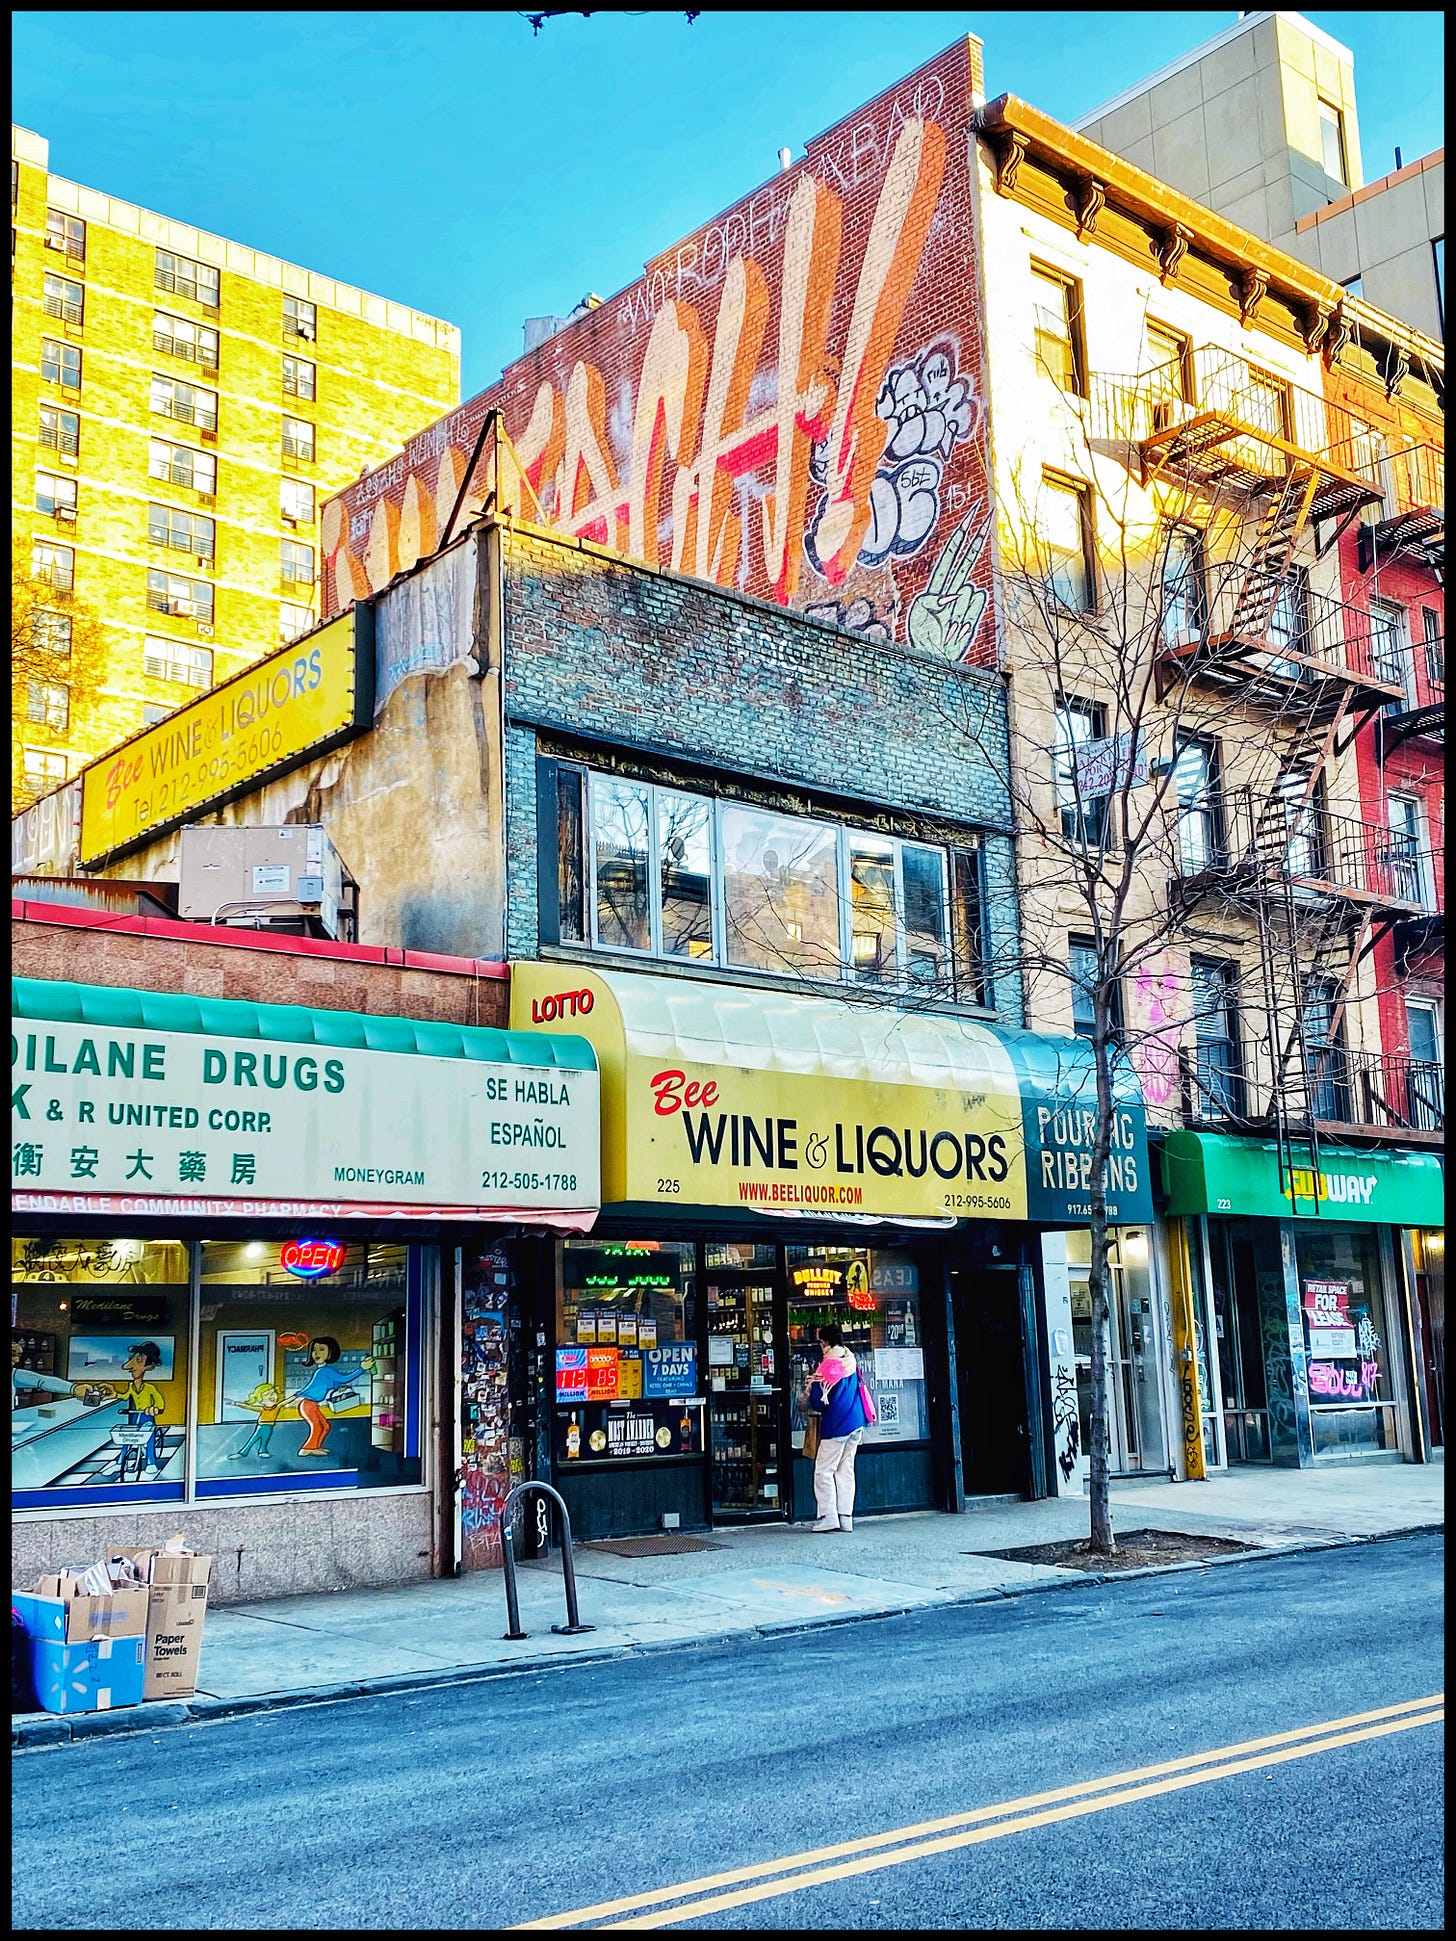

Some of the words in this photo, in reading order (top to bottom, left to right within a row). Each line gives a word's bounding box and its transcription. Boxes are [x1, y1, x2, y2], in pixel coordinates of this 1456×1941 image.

[106, 754, 143, 809] Bee
[150, 718, 202, 778] WINE
[204, 719, 218, 749] &
[220, 649, 322, 740] LIQUORS
[532, 988, 594, 1023] LOTTO
[203, 1049, 345, 1093] DRUGS
[486, 1077, 508, 1101] SE
[515, 1080, 570, 1105] HABLA
[650, 1069, 720, 1116] Bee
[46, 1099, 64, 1121] &
[78, 1101, 95, 1123] R
[108, 1102, 199, 1129] UNITED
[208, 1109, 272, 1132] CORP.
[490, 1118, 567, 1149] ESPAÑOL
[682, 1110, 798, 1170] WINE
[805, 1132, 830, 1169] &
[835, 1123, 1009, 1182] LIQUORS
[334, 1166, 425, 1186] MONEYGRAM
[1041, 1150, 1138, 1192] RIBBNS
[482, 1171, 577, 1191] 212-505-1788
[657, 1178, 680, 1194] 225
[1284, 1170, 1378, 1204] SUBWAY
[739, 1182, 863, 1205] WWW.BEELIQUOR.COM
[944, 1194, 1011, 1209] 212-995-5606
[120, 1198, 235, 1215] COMMUNITY
[243, 1202, 342, 1216] PHARMACY
[1217, 1199, 1231, 1210] 223
[284, 1246, 341, 1268] OPEN
[1328, 1285, 1348, 1295] SPACE
[1315, 1294, 1337, 1311] FOR
[648, 1348, 693, 1363] OPEN
[561, 1369, 585, 1388] 113
[597, 1368, 616, 1387] 85
[652, 1364, 658, 1376] 7
[661, 1363, 690, 1376] DAYS
[591, 1388, 616, 1396] MILLION
[613, 1447, 631, 1455] 2019
[635, 1446, 655, 1454] 2020
[155, 1633, 185, 1646] Paper
[153, 1645, 187, 1656] Towels
